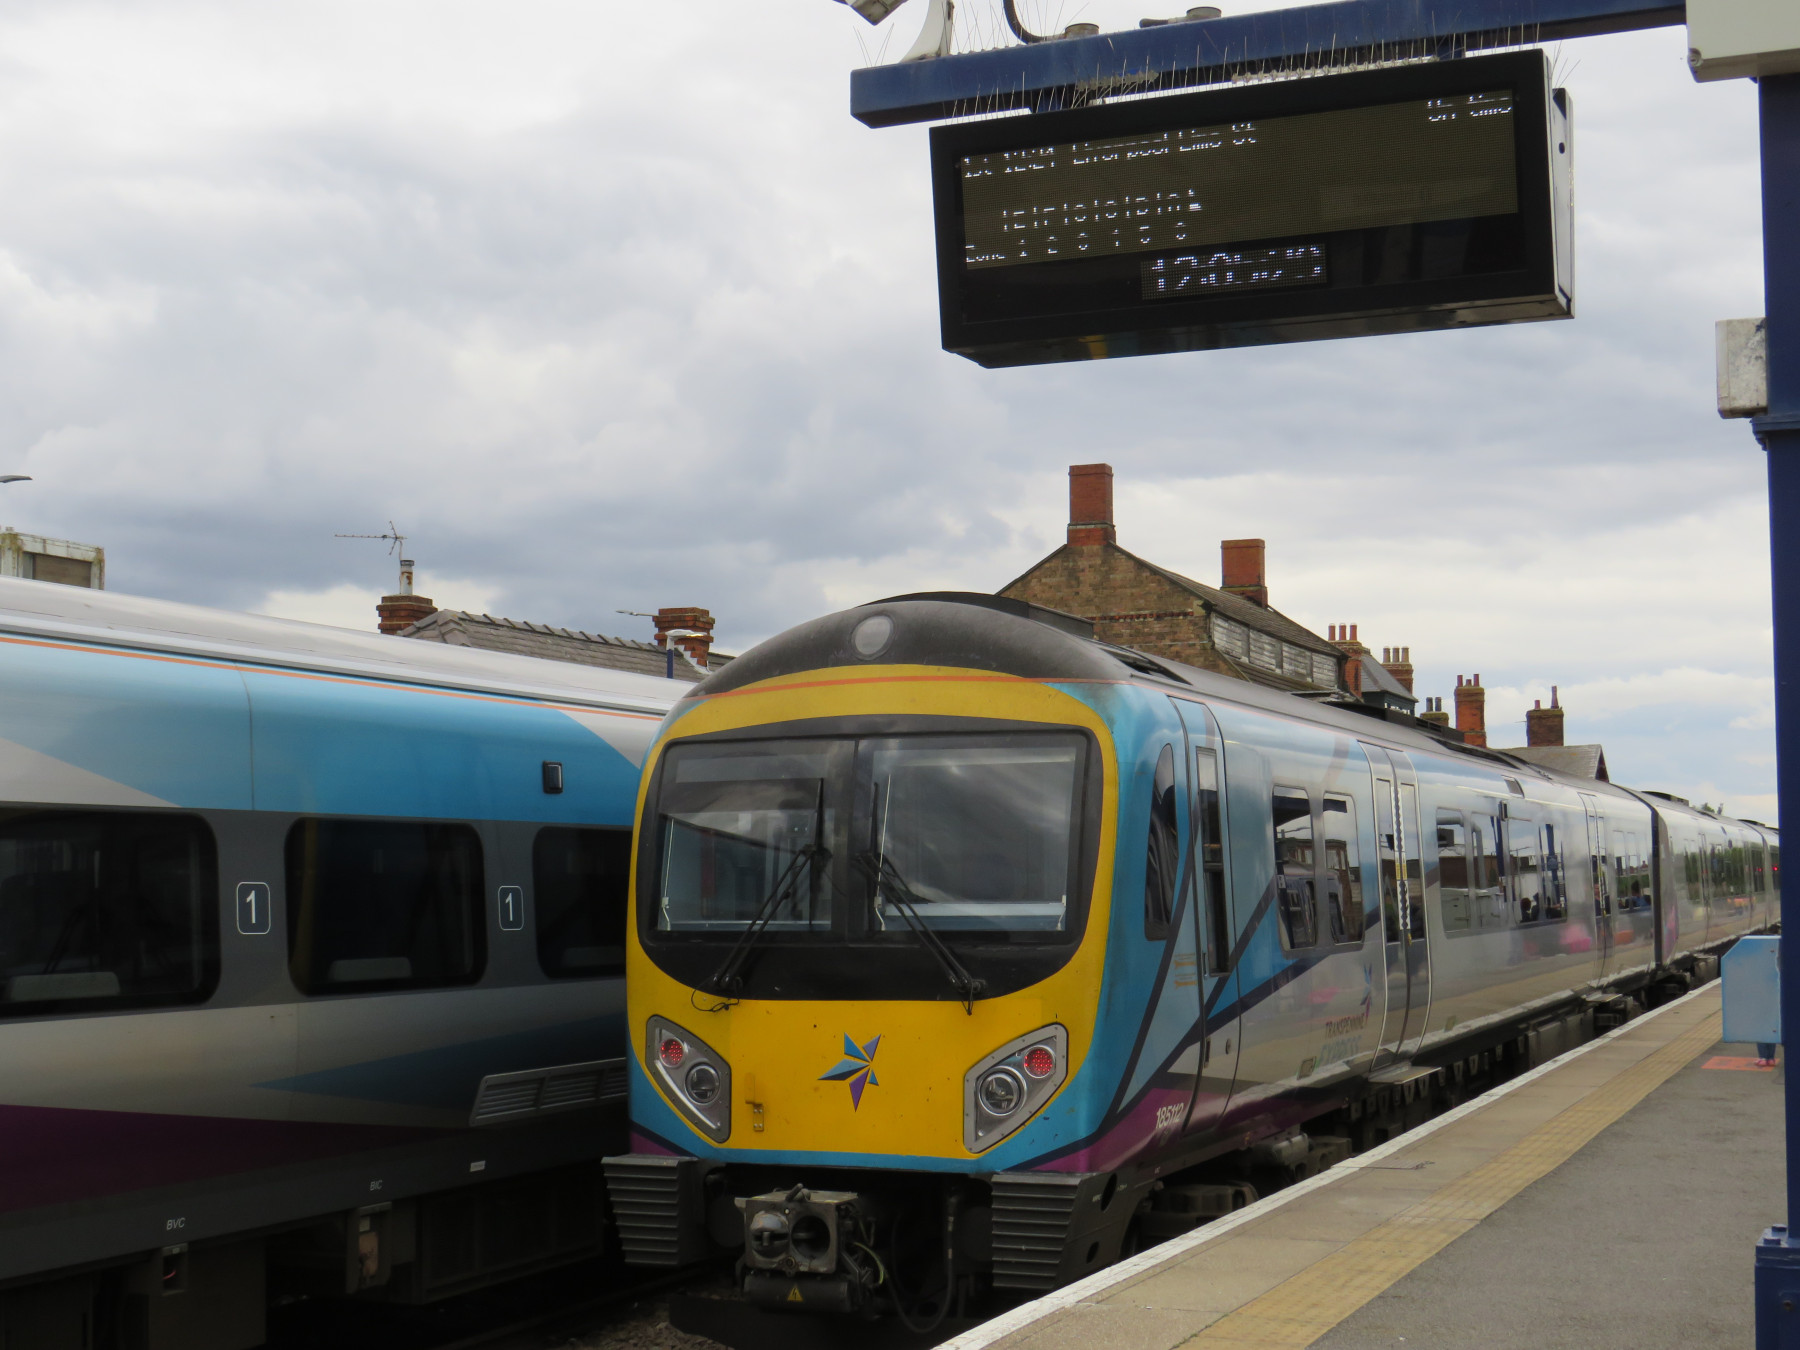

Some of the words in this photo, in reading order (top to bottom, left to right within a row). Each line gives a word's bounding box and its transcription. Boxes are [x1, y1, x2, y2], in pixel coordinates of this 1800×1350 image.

[245, 890, 256, 924] 1
[505, 892, 513, 921] 1
[1155, 1102, 1185, 1129] 185112
[369, 1179, 383, 1192] BIC
[166, 1216, 186, 1231] BVC
